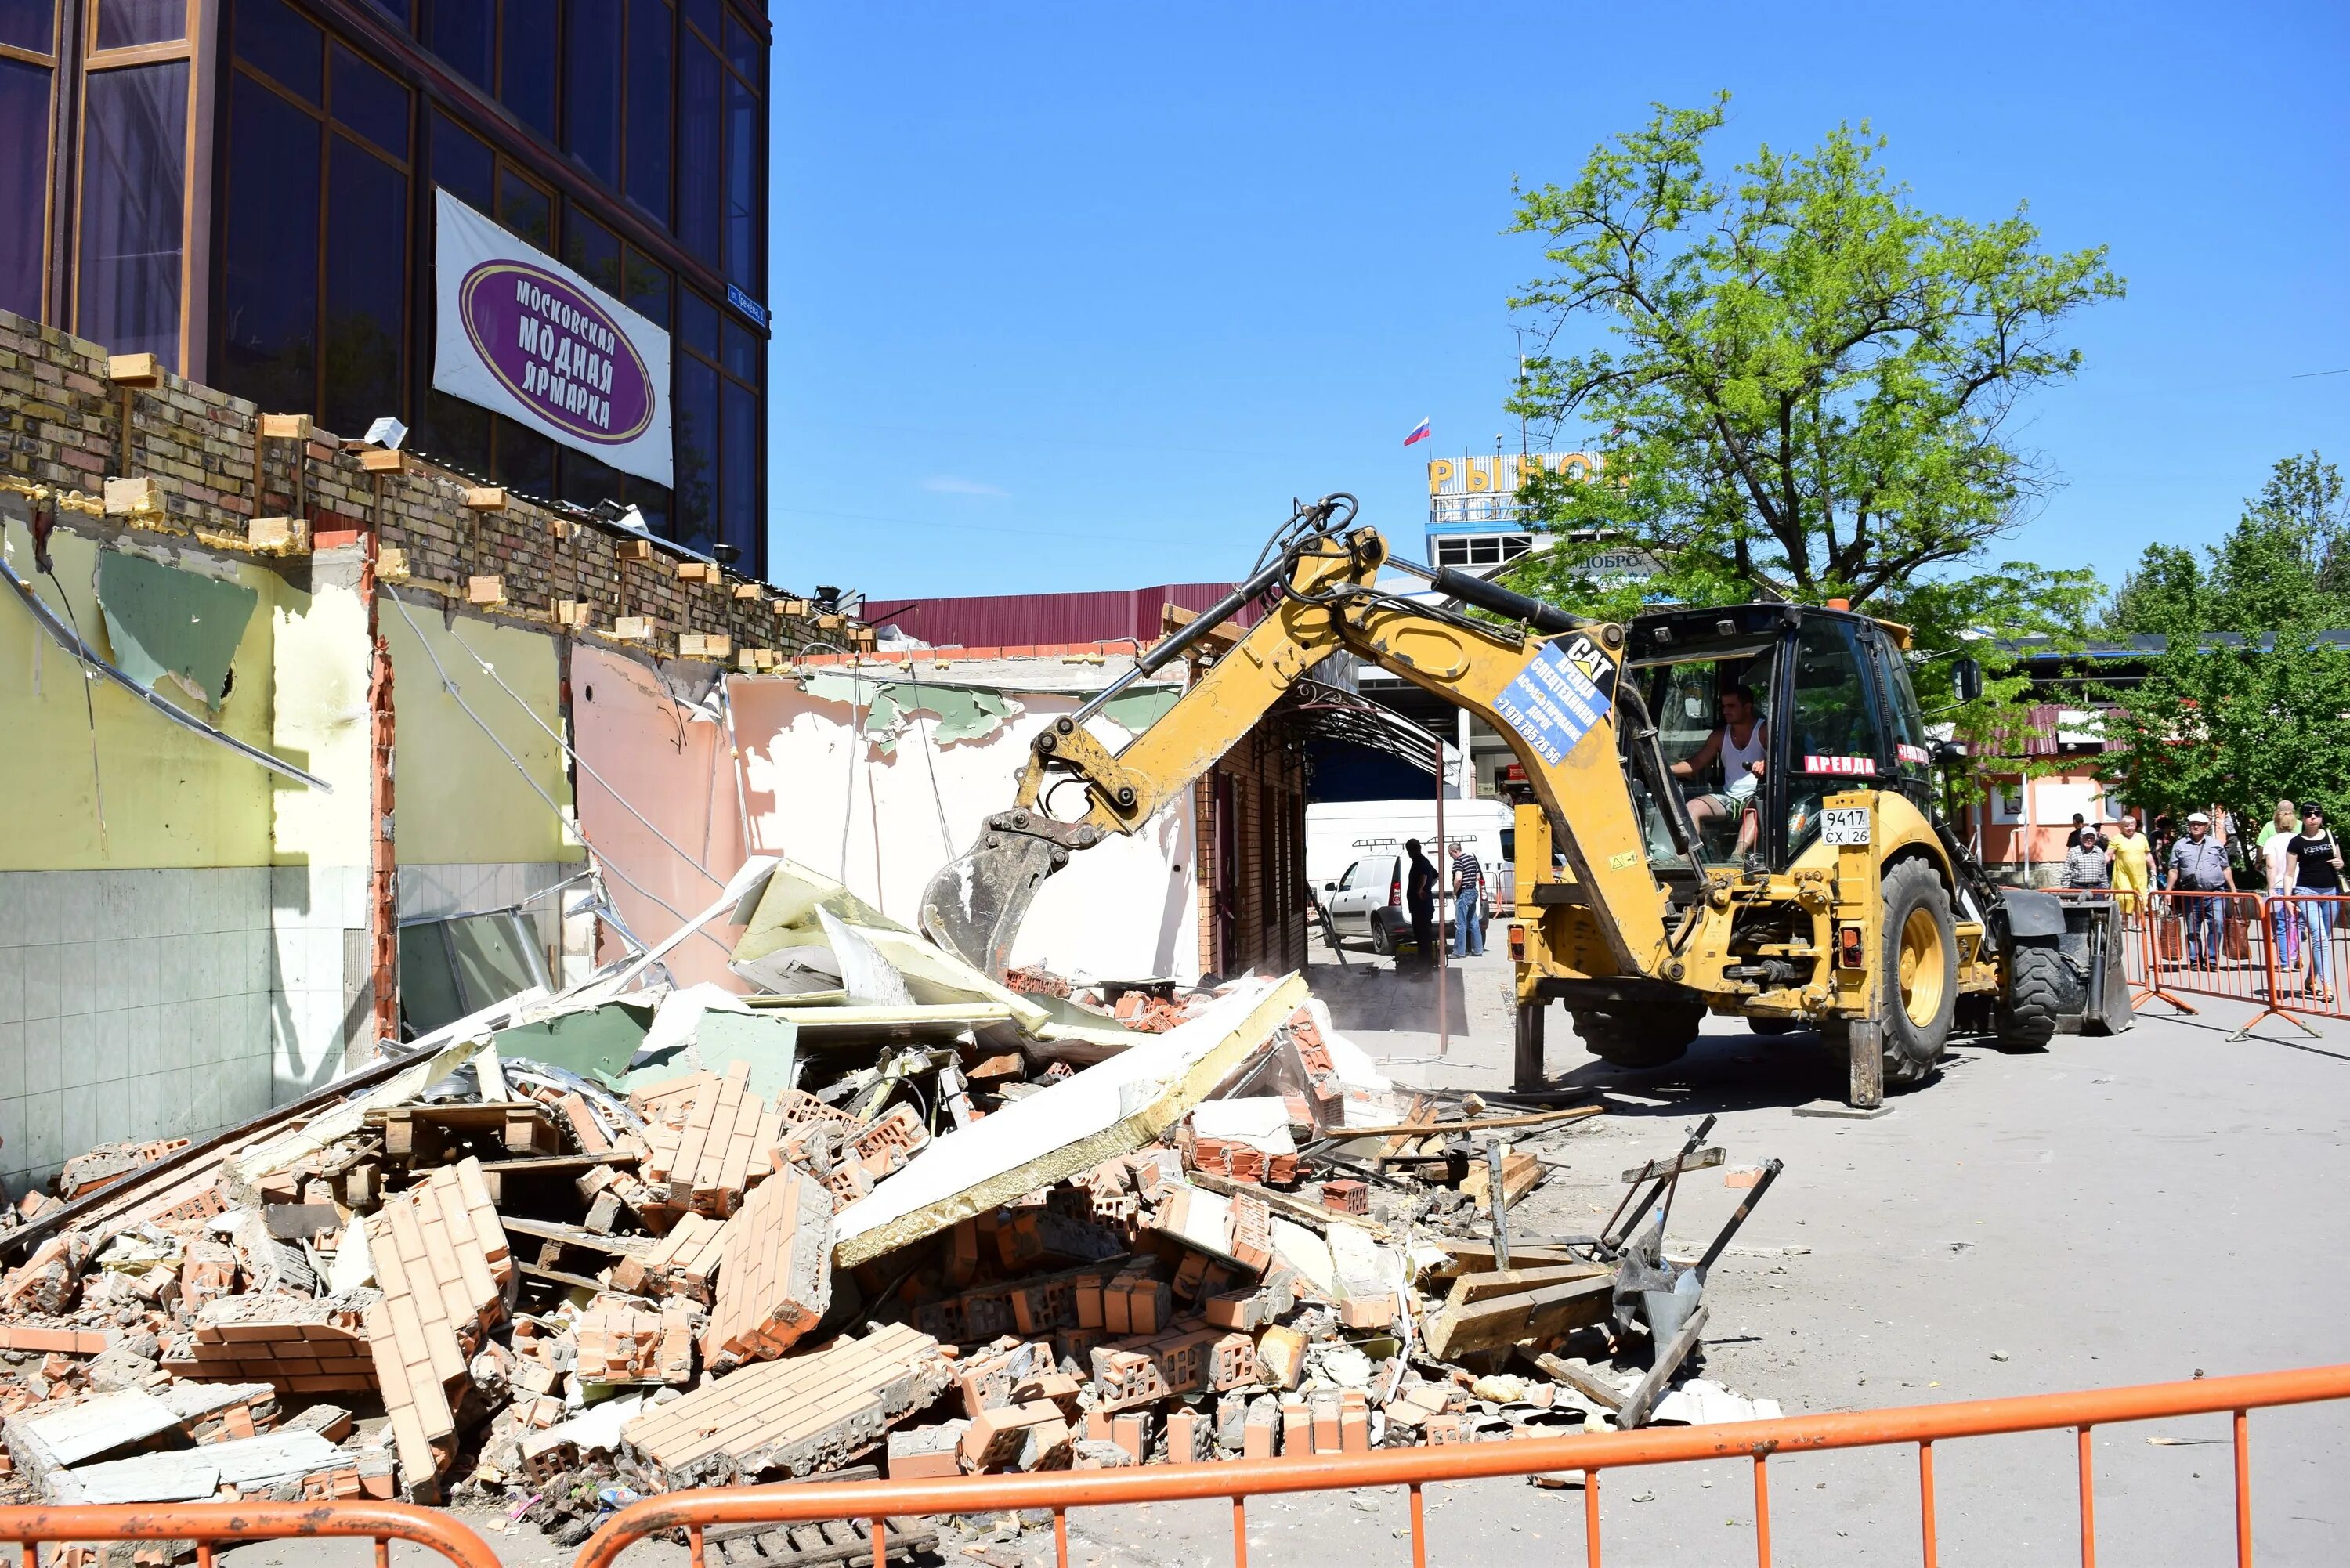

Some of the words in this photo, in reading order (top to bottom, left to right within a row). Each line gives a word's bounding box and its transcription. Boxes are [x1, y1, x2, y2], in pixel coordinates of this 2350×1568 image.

[516, 279, 615, 356] МОСКОВСКАЯ
[519, 315, 613, 395] МОДНАЯ
[522, 361, 610, 430] ЯРМАРКА
[1579, 555, 1640, 570] ДОБРО
[1555, 656, 1598, 701] АРЕНДА
[1567, 637, 1614, 684] CAT
[1515, 673, 1583, 743] АСФАЛЬТИРОВАНИЕ
[1530, 656, 1599, 728] СПЕЦТЕХНИКИ
[1497, 698, 1511, 711] +7
[1504, 705, 1525, 727] 978
[1519, 719, 1540, 742] 735
[1533, 735, 1551, 753] 26
[1545, 746, 1562, 765] 56
[1525, 704, 1553, 732] ДОРОГ
[1807, 756, 1875, 775] АРЕНДА
[1826, 832, 1843, 843] СХ
[1853, 831, 1867, 842] 26
[1827, 811, 1864, 826] 9417
